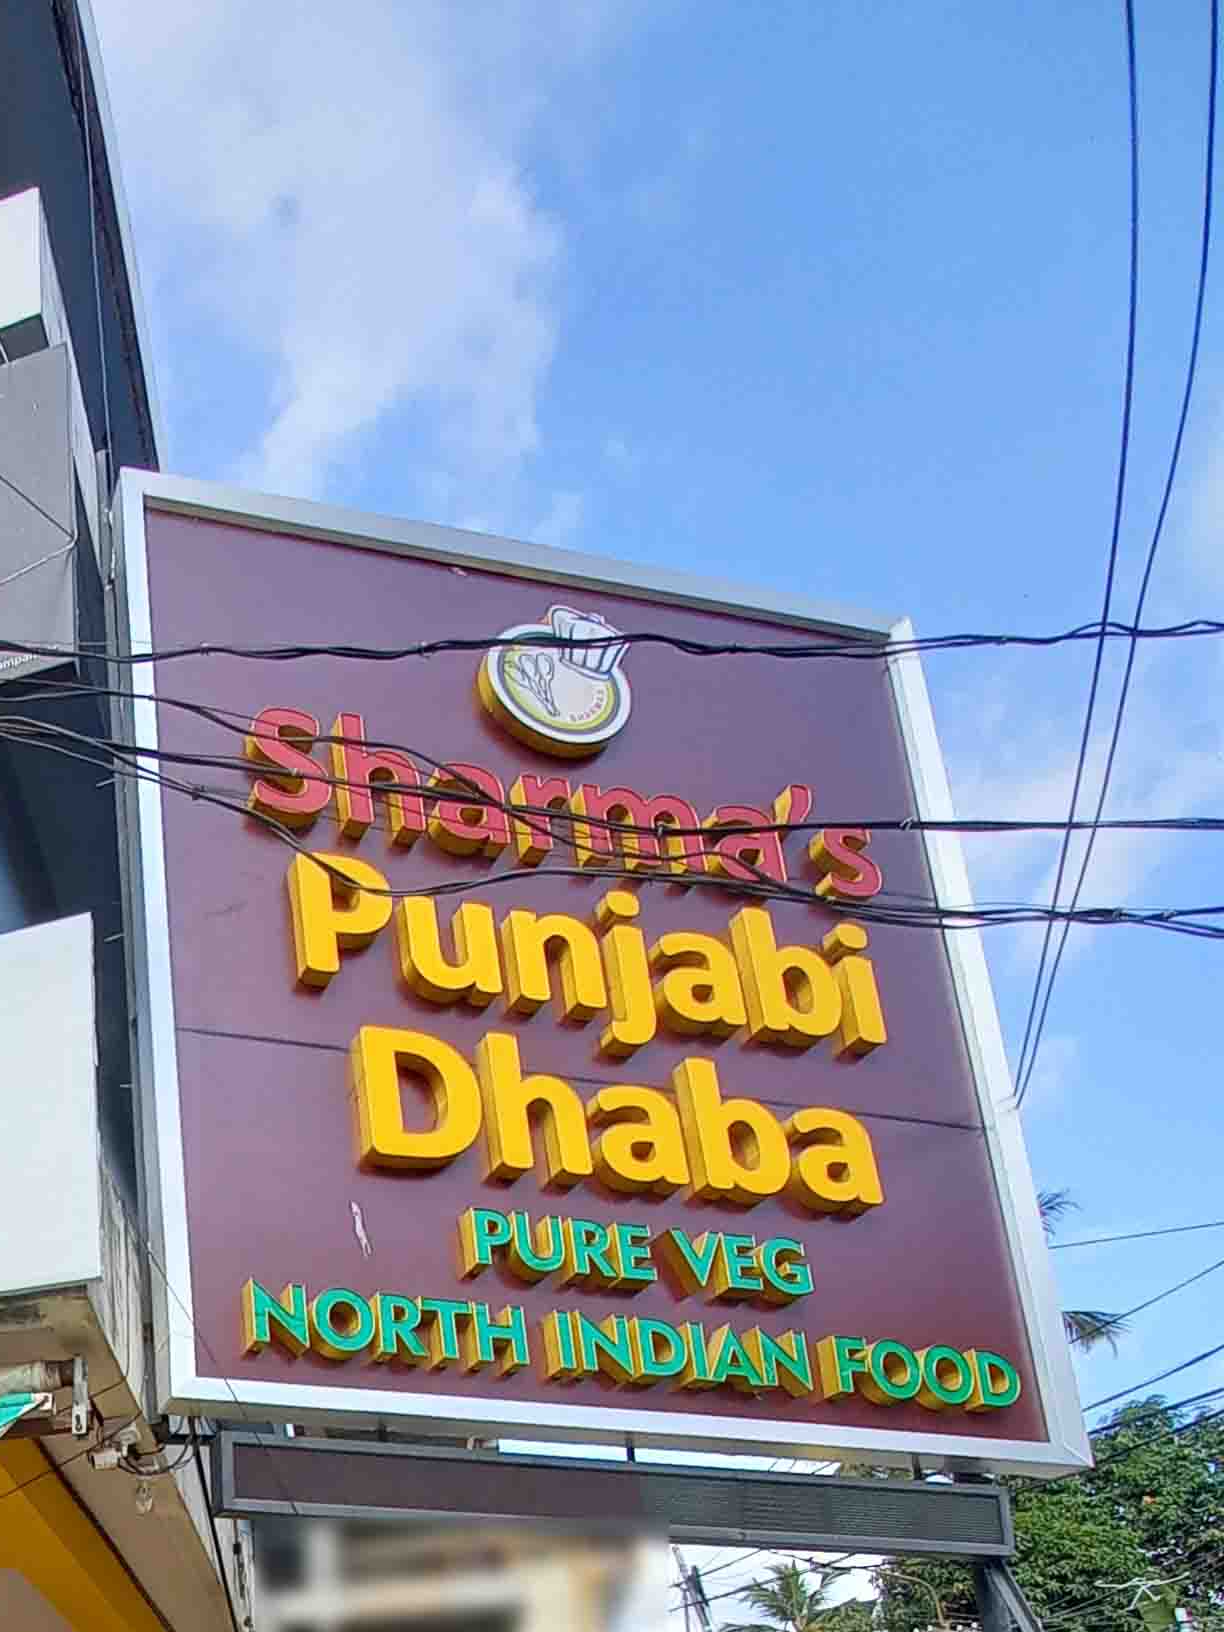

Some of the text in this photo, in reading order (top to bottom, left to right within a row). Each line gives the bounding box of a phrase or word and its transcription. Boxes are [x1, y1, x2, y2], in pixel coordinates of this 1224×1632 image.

[246, 707, 882, 899] Sharma's
[288, 852, 887, 1057] Punjabi
[352, 1025, 884, 1216] Dhaba
[242, 1277, 1022, 1413] NORTH INDIAN FOOD
[459, 1207, 816, 1303] PURE VEG
